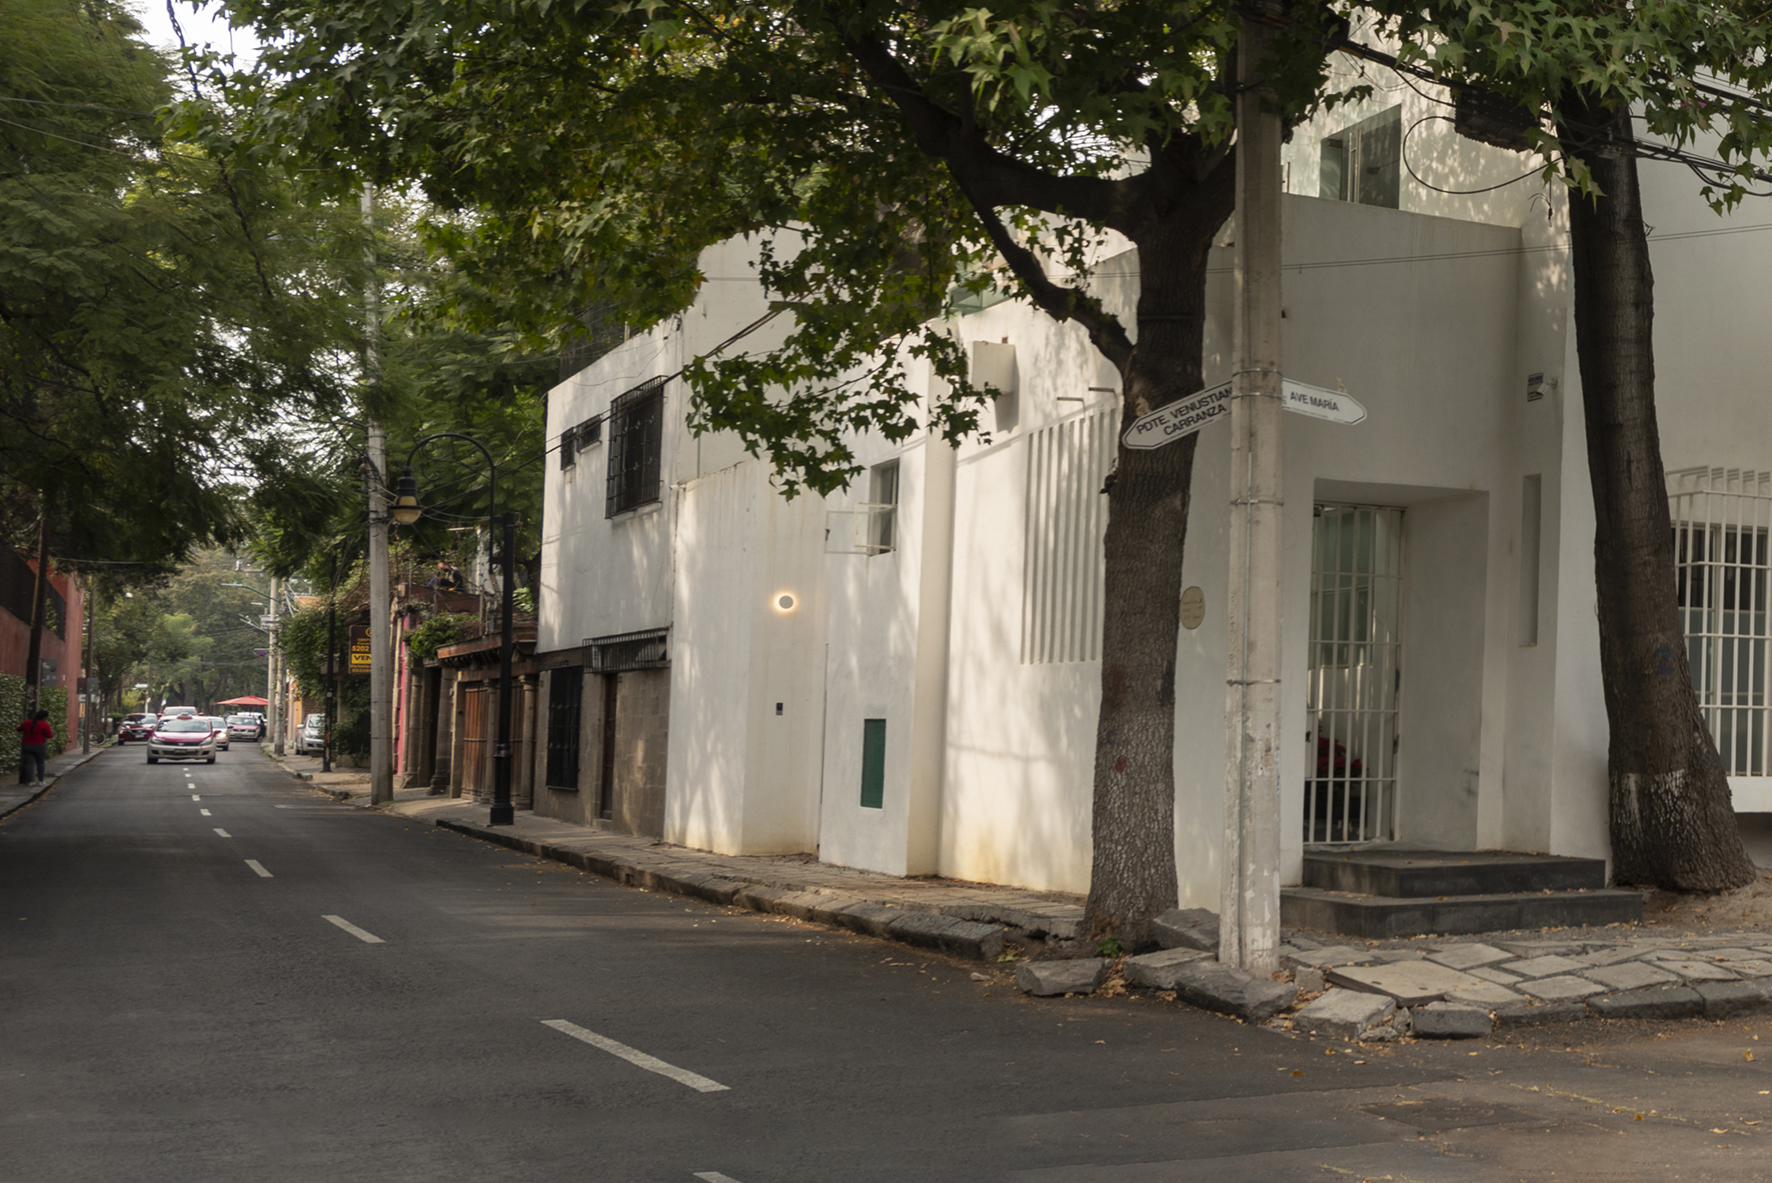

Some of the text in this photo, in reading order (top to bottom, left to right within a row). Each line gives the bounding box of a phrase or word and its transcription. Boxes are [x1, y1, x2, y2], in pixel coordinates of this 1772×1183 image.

[1290, 391, 1309, 404] AVE
[1310, 396, 1340, 412] MARÍA
[1136, 415, 1170, 434] PDTE.
[1163, 404, 1227, 435] CARRANZA
